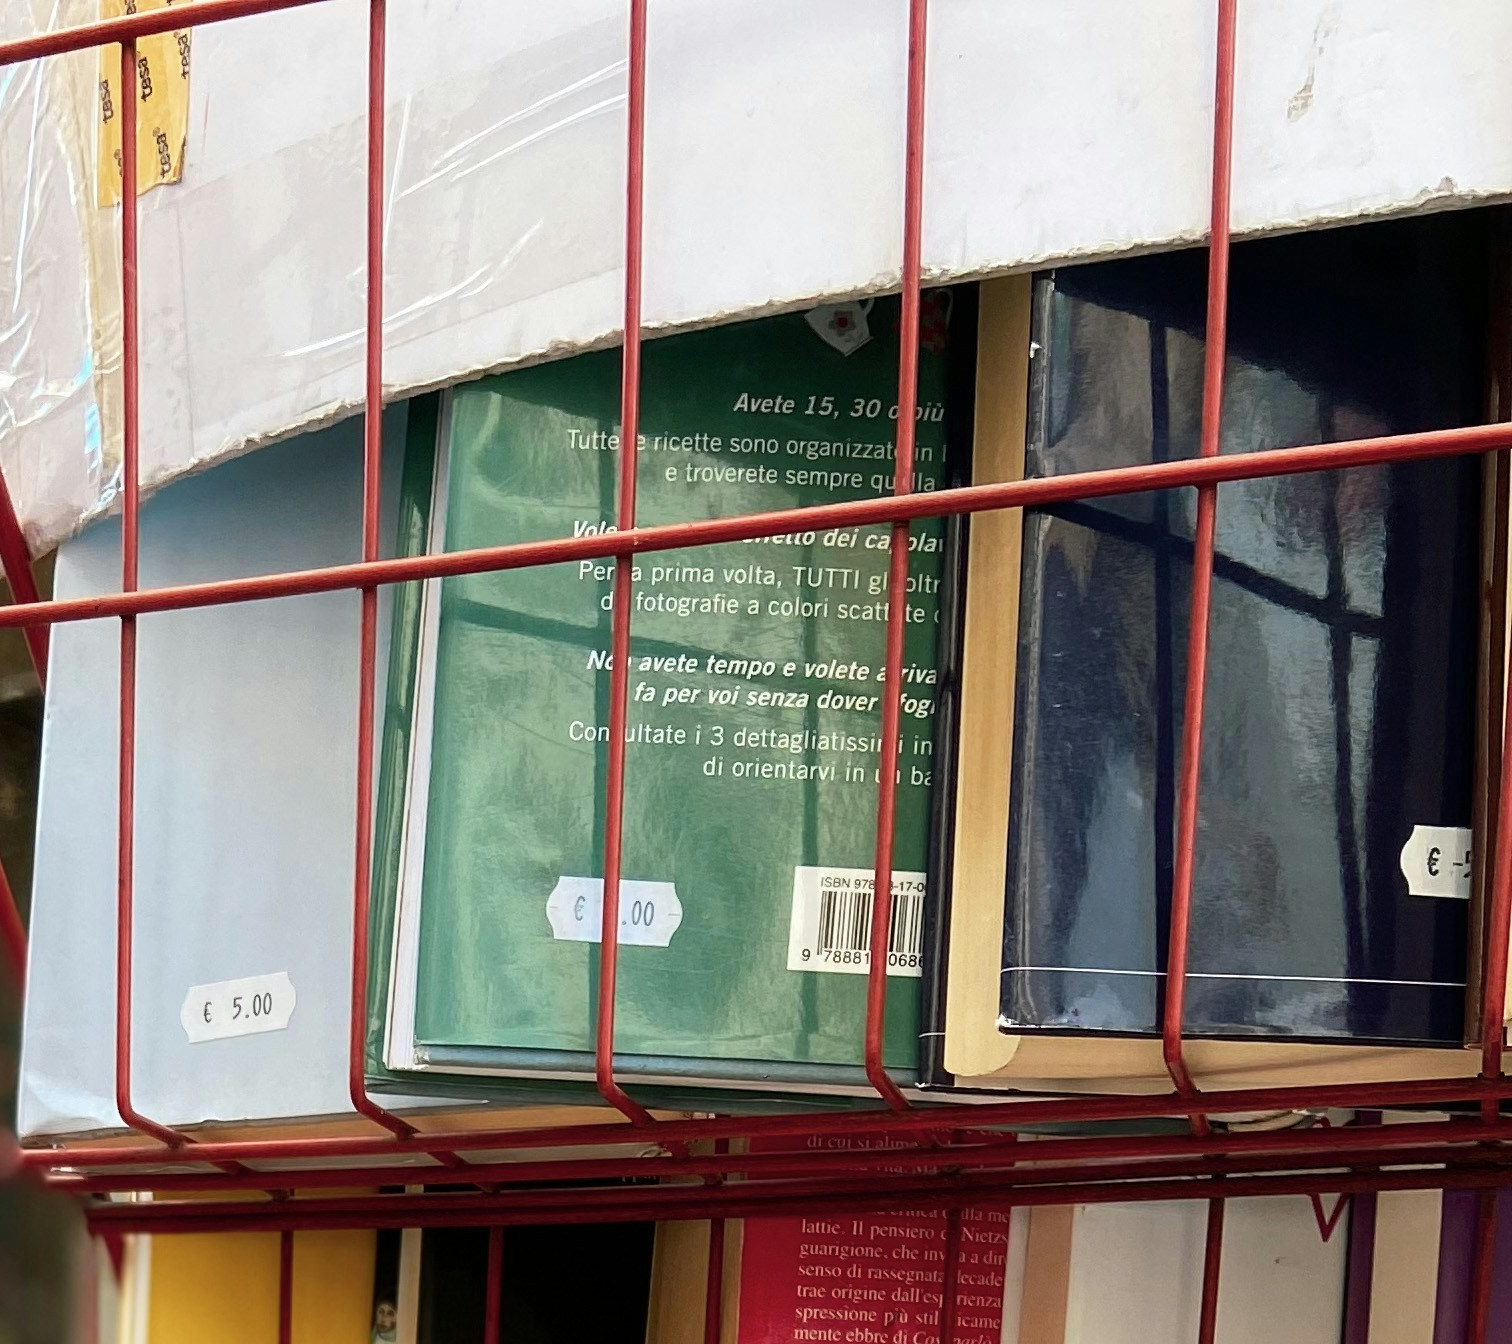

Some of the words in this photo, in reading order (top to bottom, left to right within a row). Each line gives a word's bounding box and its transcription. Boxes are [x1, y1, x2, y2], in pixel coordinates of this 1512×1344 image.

[733, 392, 795, 414] Avete
[804, 395, 839, 419] 15,
[850, 398, 881, 418] 30
[567, 428, 619, 450] Tutte
[654, 430, 722, 452] ricette
[729, 437, 779, 454] sono
[786, 438, 897, 461] organizzat
[665, 466, 677, 482] e
[686, 462, 778, 484] troverete
[785, 469, 863, 491] sempre
[870, 472, 935, 494] qulla
[823, 528, 859, 549] dei
[579, 560, 615, 580] Per
[651, 562, 714, 586] prima
[723, 565, 782, 589] volta,
[793, 566, 859, 589] TUTTI
[868, 571, 888, 595] gl
[636, 591, 739, 617] fotografie
[747, 601, 760, 616] a
[768, 597, 828, 618] colori
[837, 601, 925, 623] scattte
[639, 654, 698, 674] avete
[706, 655, 776, 679] tempo
[782, 662, 796, 676] e
[804, 659, 870, 682] volete
[876, 664, 937, 685] ariva
[634, 682, 656, 702] fa
[662, 686, 701, 707] per
[708, 685, 741, 705] voi
[746, 690, 809, 708] senza
[817, 689, 878, 712] dover
[569, 721, 686, 745] Conultate
[695, 724, 702, 745] i
[710, 725, 724, 746] 3
[733, 727, 903, 755] dettagliatissii
[703, 756, 723, 776] di
[732, 757, 835, 781] orientarvi
[845, 761, 865, 783] in
[821, 876, 851, 888] ISBN
[621, 900, 655, 926] .00
[232, 992, 272, 1021] 5.00
[870, 1224, 935, 1241] pensiero
[892, 1244, 919, 1260] che
[798, 1263, 842, 1279] senso
[847, 1263, 862, 1279] di
[797, 1284, 826, 1298] trae
[832, 1284, 886, 1303] origine
[795, 1305, 877, 1323] spressione
[884, 1307, 908, 1326] più
[794, 1327, 841, 1342] mente
[846, 1327, 888, 1344] ebbre
[893, 1331, 908, 1344] di
